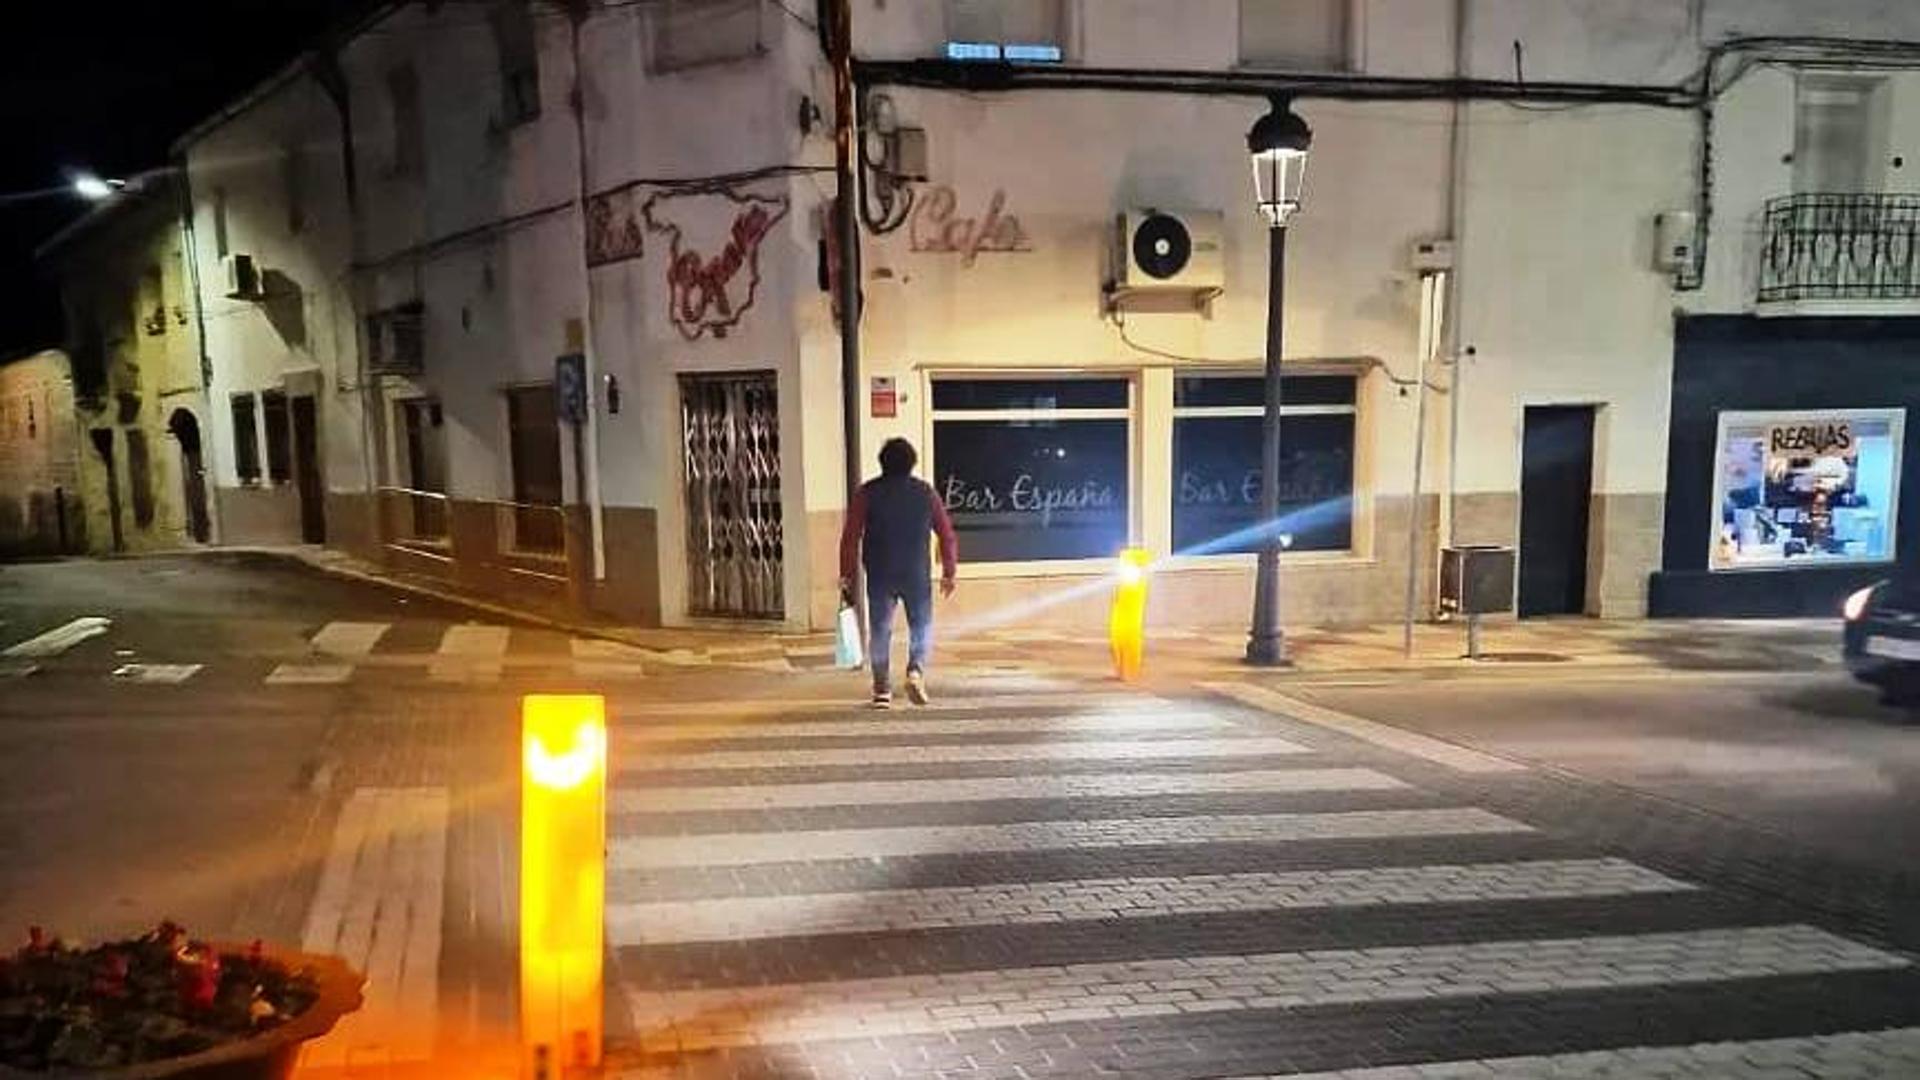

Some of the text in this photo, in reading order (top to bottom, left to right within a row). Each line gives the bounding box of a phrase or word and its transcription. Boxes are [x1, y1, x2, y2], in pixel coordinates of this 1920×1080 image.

[944, 474, 1116, 528] Bar España
[1180, 470, 1229, 502] Bar
